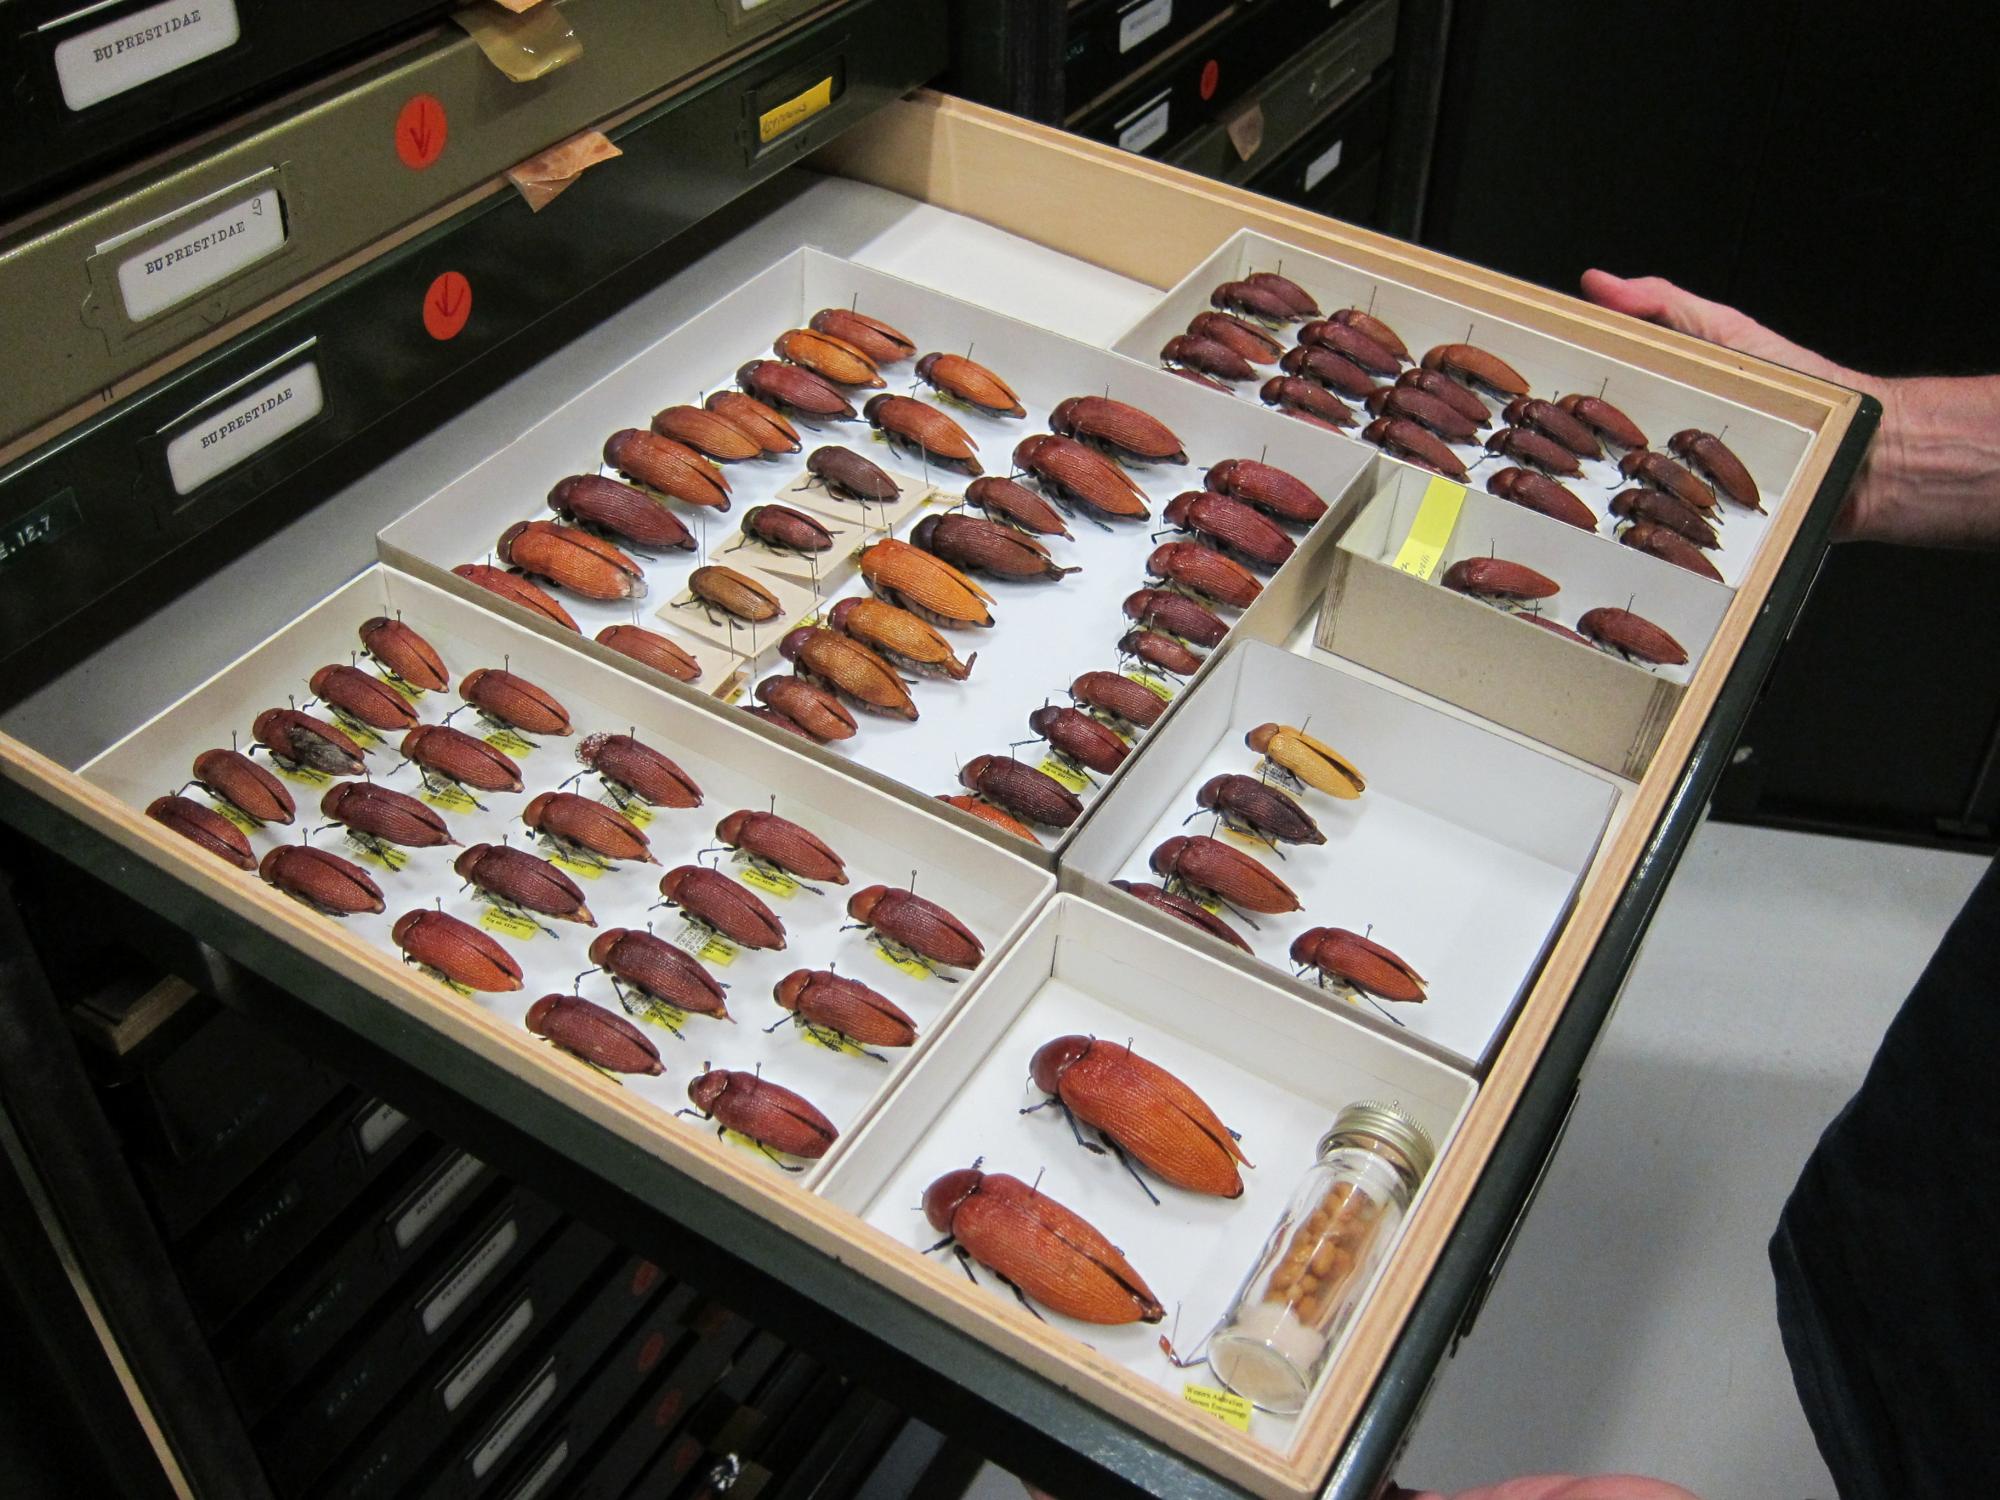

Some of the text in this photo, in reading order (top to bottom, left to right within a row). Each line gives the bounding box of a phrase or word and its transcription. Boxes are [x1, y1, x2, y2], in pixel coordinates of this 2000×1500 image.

[92, 9, 202, 63] BUPRESTIDAE
[144, 221, 246, 275] BUPRESTIDAE
[200, 387, 293, 449] BUPRESTIDAE
